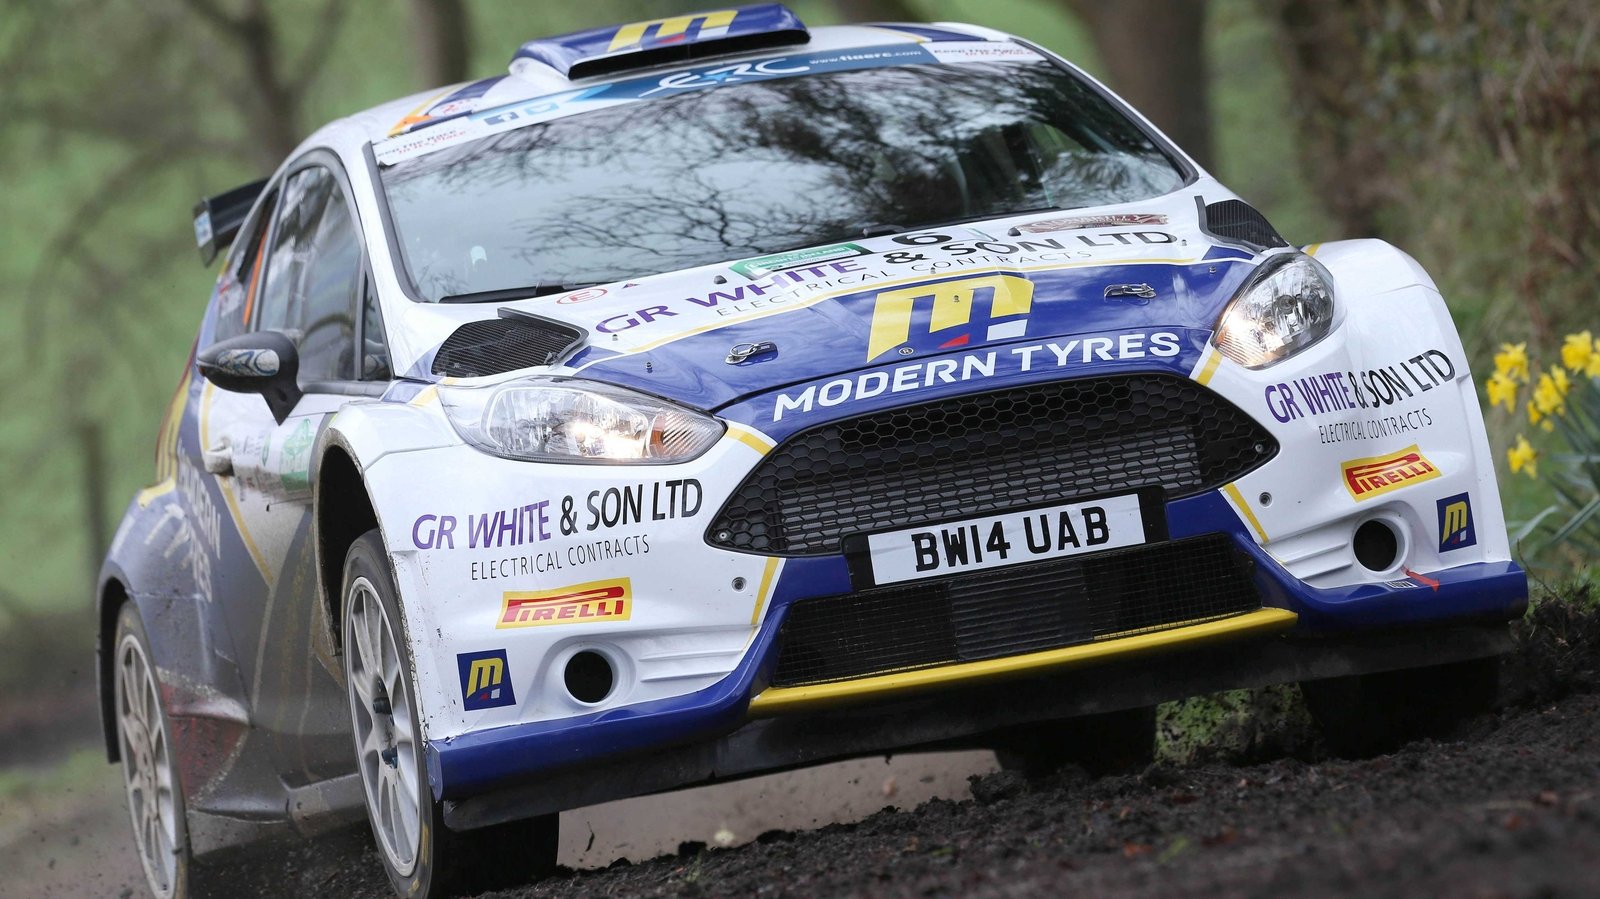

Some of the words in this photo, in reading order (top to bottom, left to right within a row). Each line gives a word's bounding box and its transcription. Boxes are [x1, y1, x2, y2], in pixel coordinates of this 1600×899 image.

[596, 305, 679, 333] GR
[685, 259, 867, 308] WHITE
[883, 251, 930, 264] &
[940, 238, 1066, 256] SON
[1077, 231, 1178, 246] LTD
[716, 270, 897, 317] ELECTRICAL
[911, 250, 1093, 272] CONTRACTS
[772, 352, 998, 422] MODERN
[1011, 332, 1181, 372] TYRES
[1264, 382, 1304, 424] GR
[1293, 371, 1356, 416] WHITE
[1348, 371, 1370, 409] &
[1360, 365, 1414, 409] SON
[1400, 348, 1456, 393] LTD
[1318, 421, 1367, 445] ELECTRICAL
[1367, 407, 1433, 440] CONTRACTS
[1345, 452, 1434, 495] PIRELLI
[412, 513, 457, 549] GR
[468, 500, 551, 549] WHITE
[559, 494, 578, 536] &
[586, 483, 643, 532] SON
[652, 478, 703, 521] LTD
[911, 519, 1011, 572] BW14
[1023, 506, 1110, 555] UAB
[471, 551, 563, 581] ELECTRICAL
[567, 534, 650, 566] CONTRACTS
[501, 585, 625, 623] PIRELLI
